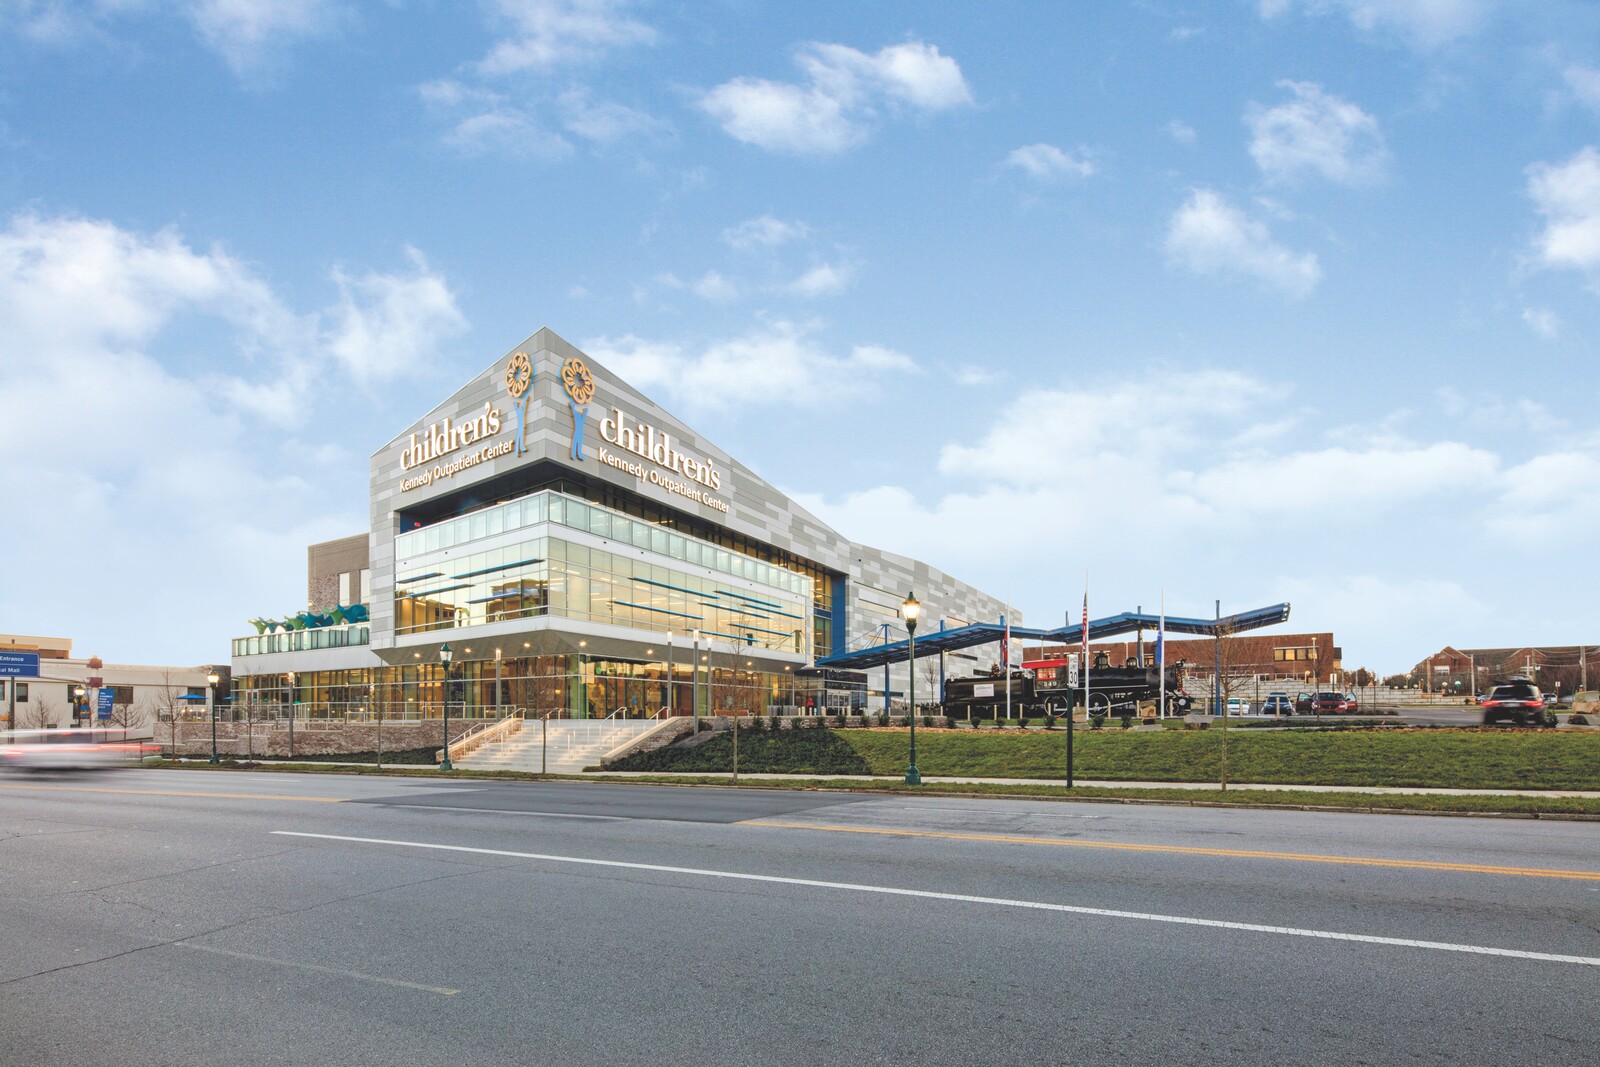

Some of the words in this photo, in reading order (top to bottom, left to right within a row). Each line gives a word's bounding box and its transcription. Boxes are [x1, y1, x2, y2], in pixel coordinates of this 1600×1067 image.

[400, 401, 501, 471] children's
[400, 469, 434, 492] Kennedy
[433, 451, 480, 479] Outpatient
[481, 439, 514, 462] Center
[599, 408, 721, 490] children's
[598, 447, 648, 483] Kennedy
[649, 470, 701, 502] Outpatient
[702, 492, 730, 513] Center
[1069, 671, 1078, 684] 30
